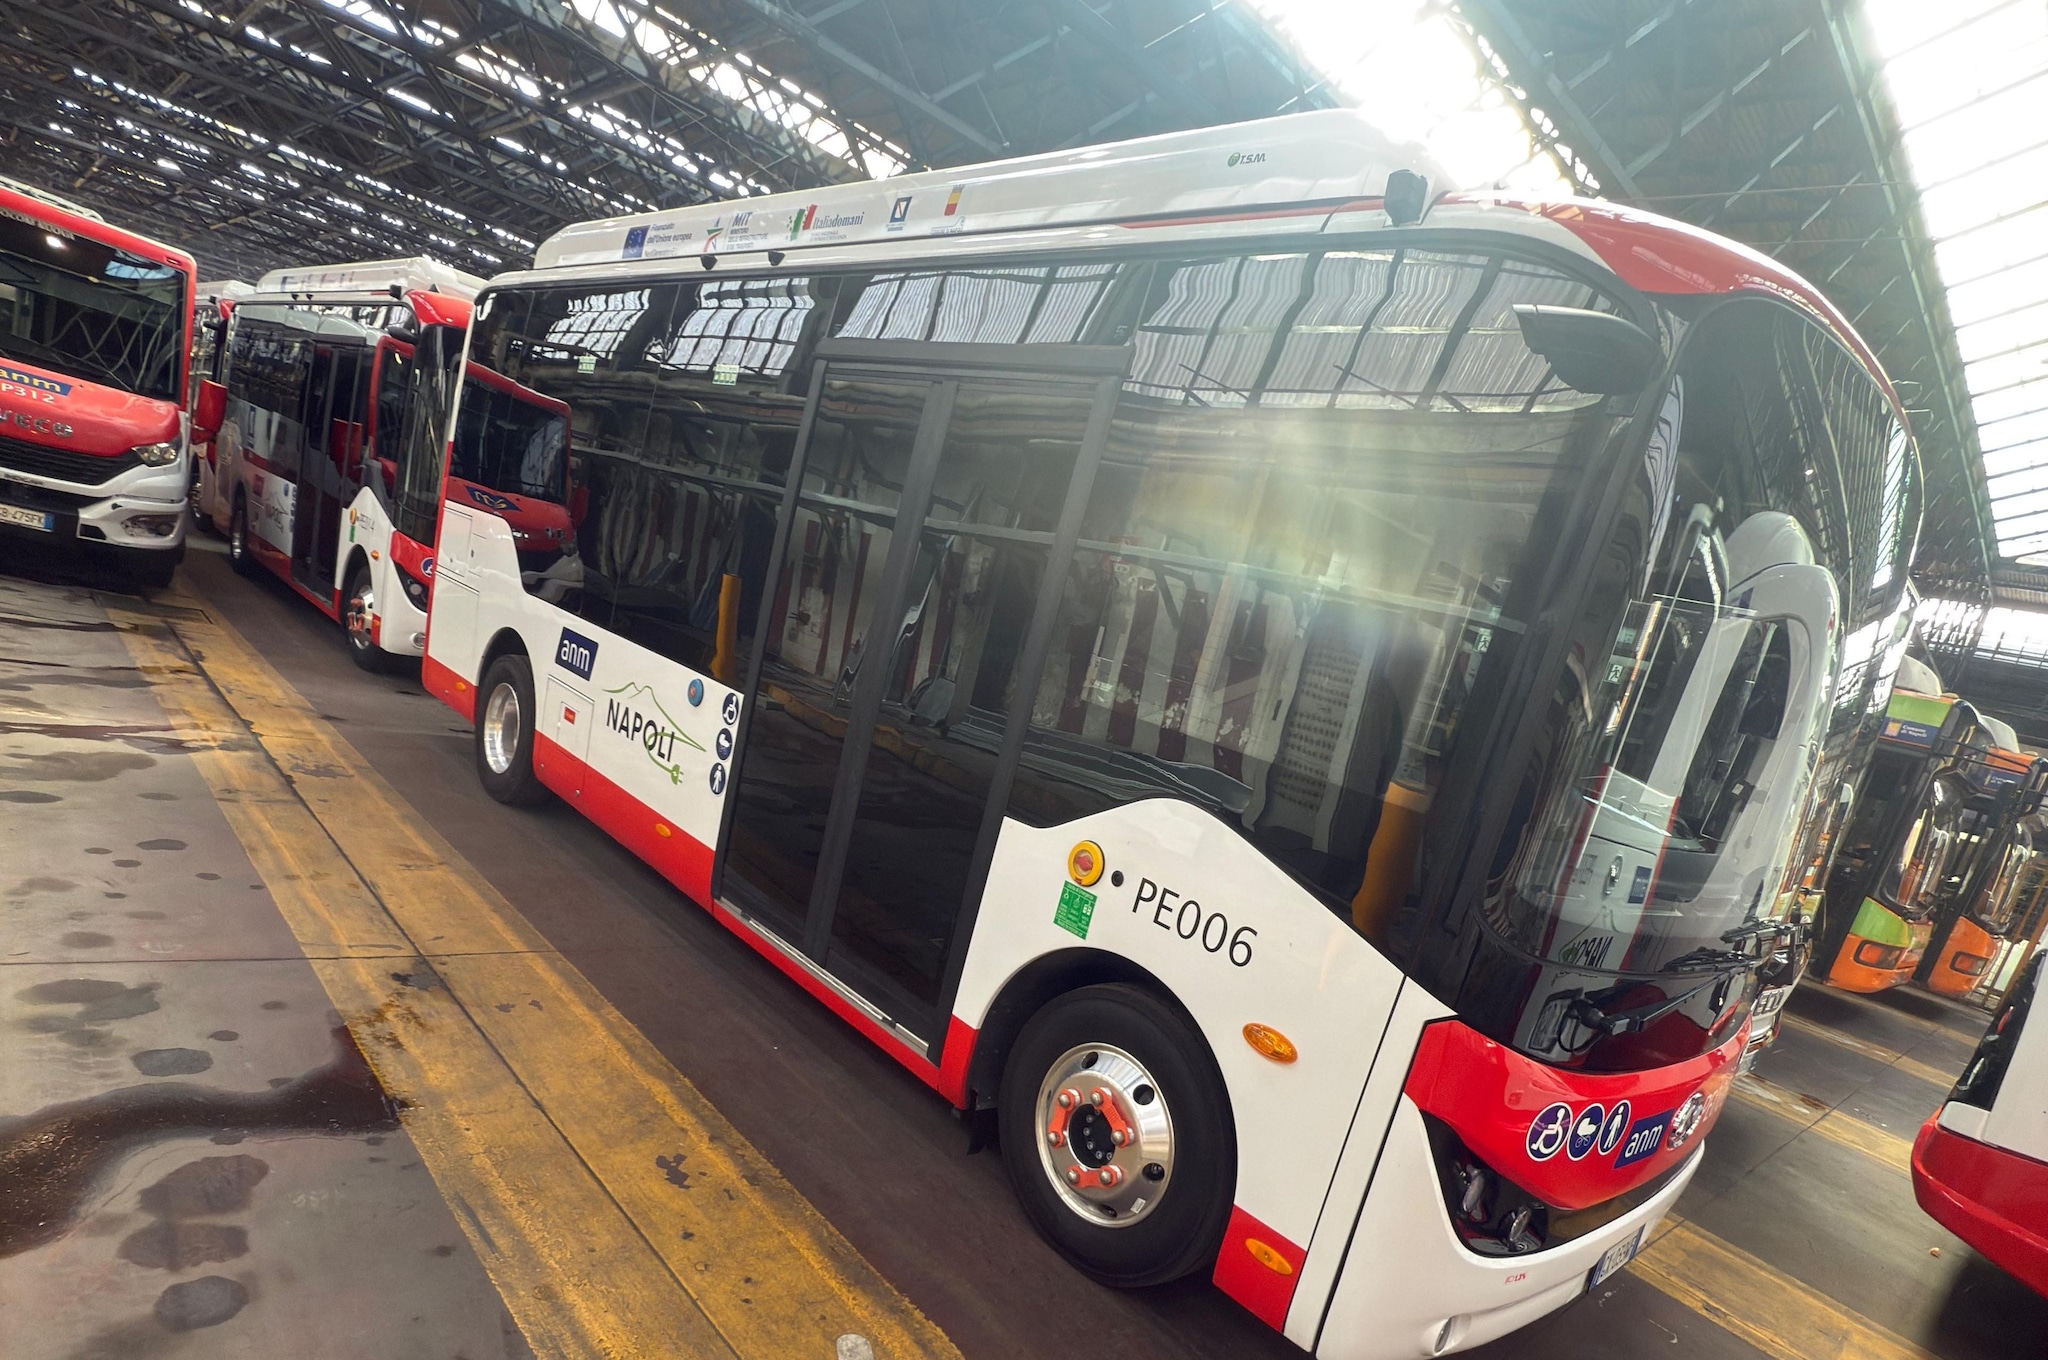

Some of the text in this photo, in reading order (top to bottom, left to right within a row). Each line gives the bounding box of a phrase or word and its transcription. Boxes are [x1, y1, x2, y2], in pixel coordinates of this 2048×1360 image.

[731, 211, 753, 227] MIT
[812, 211, 865, 230] Italiadomani
[1, 382, 55, 405] P312
[560, 639, 591, 672] anm
[606, 698, 675, 763] NAPOLI
[1131, 876, 1258, 967] PE006
[1624, 1124, 1663, 1158] anm
